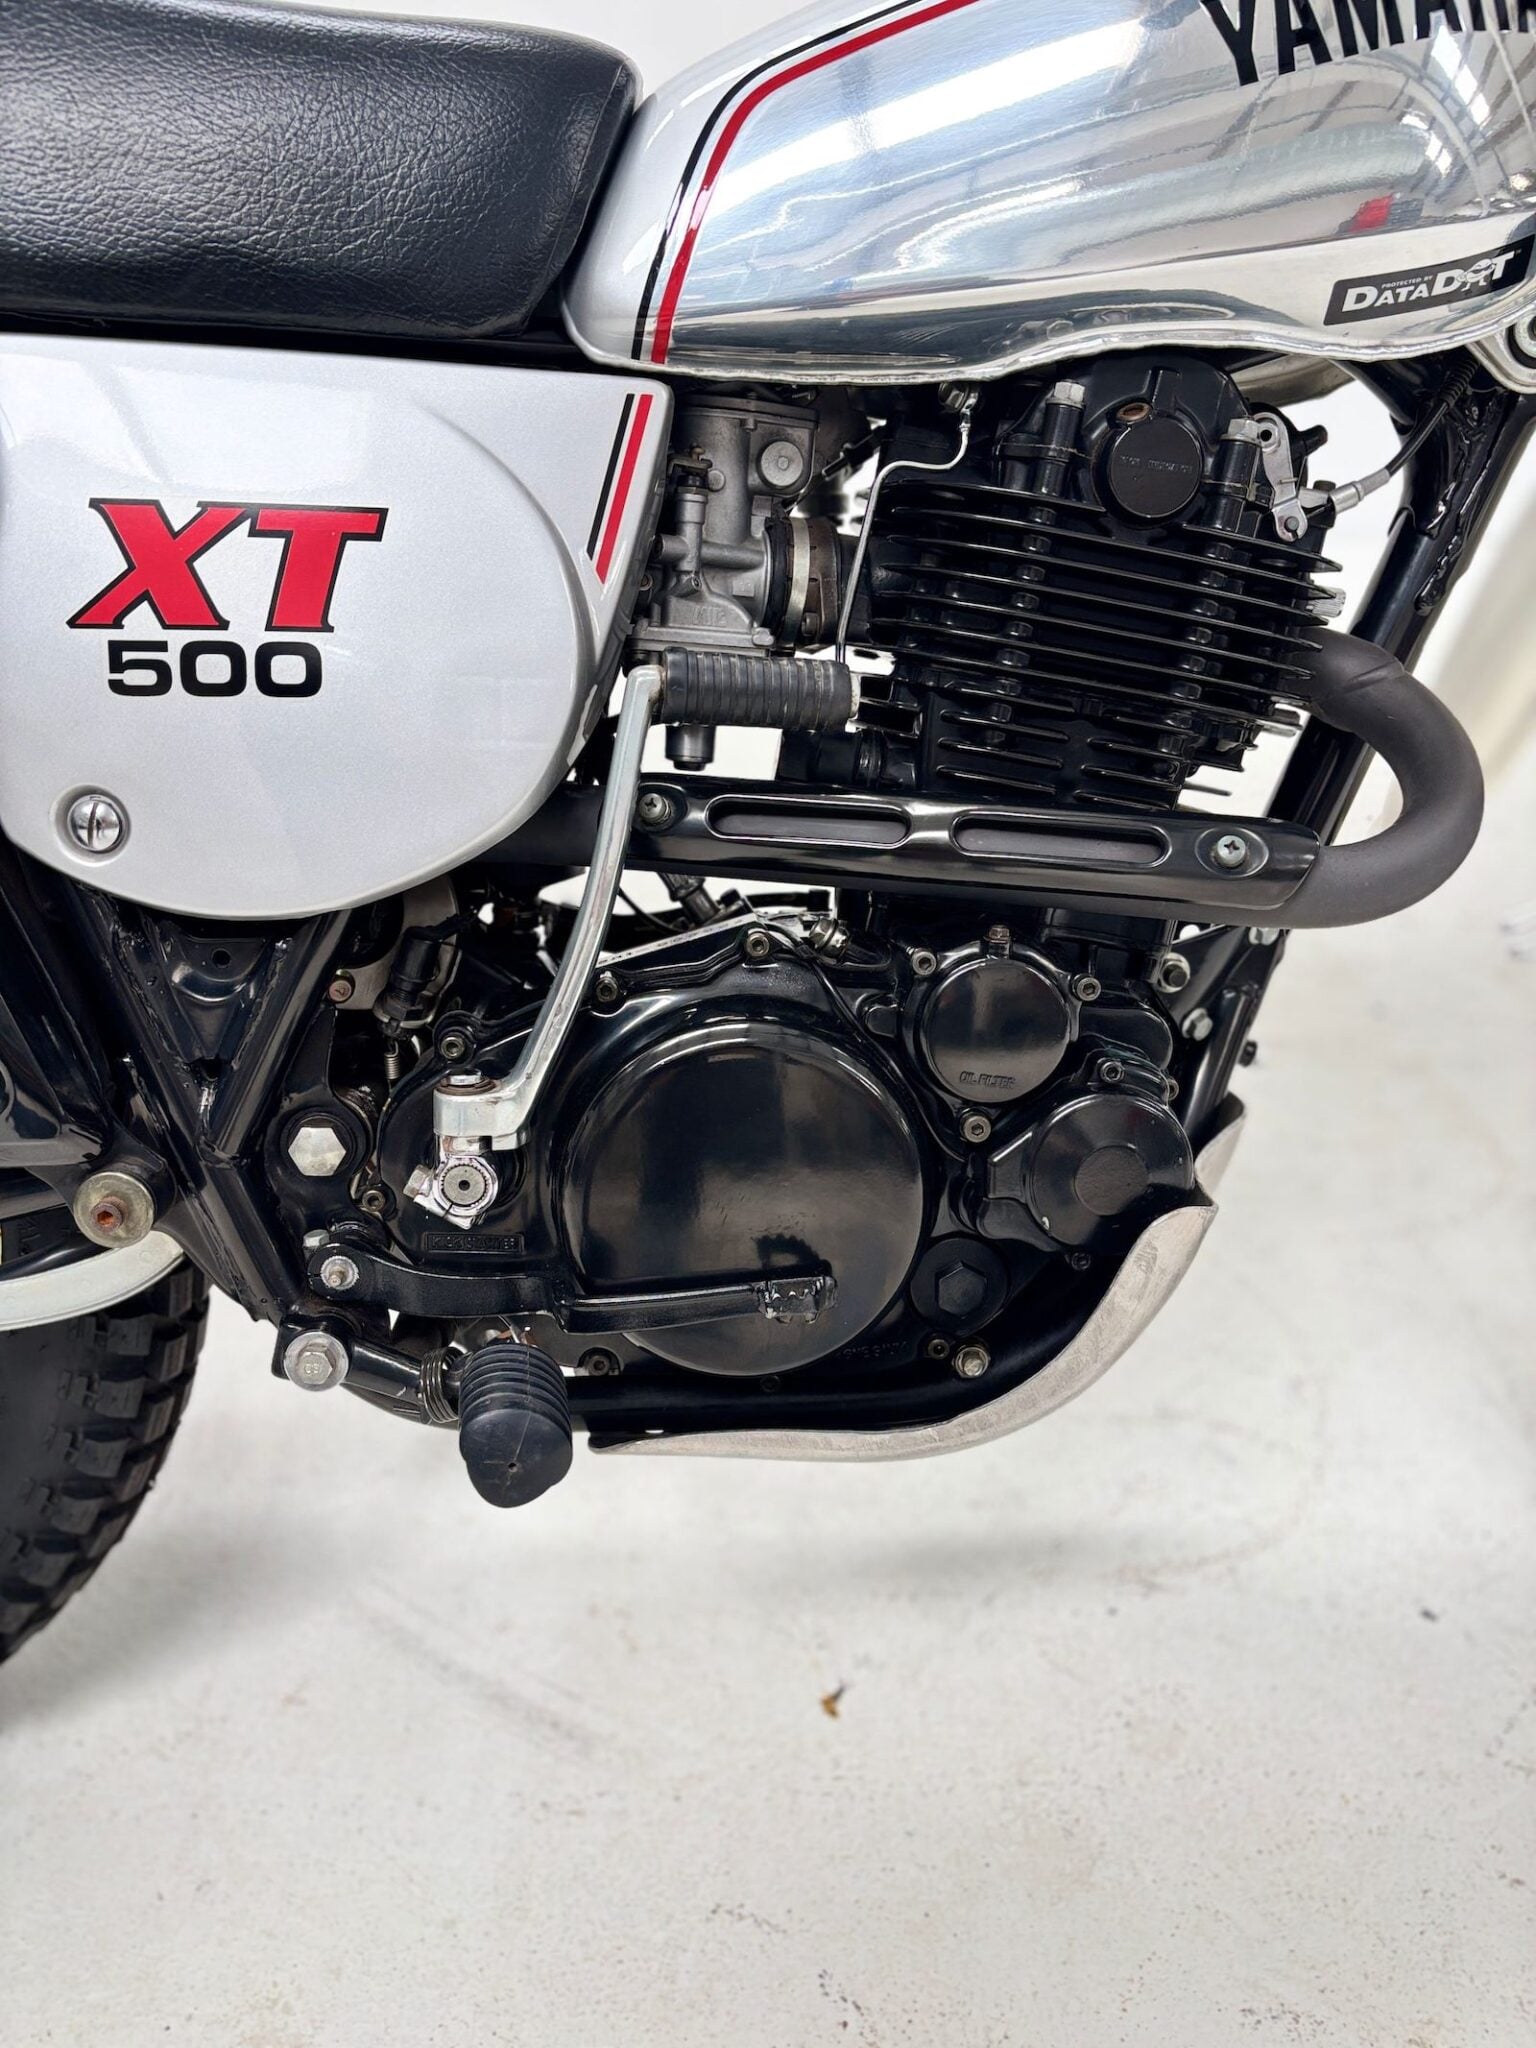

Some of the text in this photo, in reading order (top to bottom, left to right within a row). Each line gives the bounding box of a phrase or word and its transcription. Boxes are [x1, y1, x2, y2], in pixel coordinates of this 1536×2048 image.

[1381, 277, 1422, 289] PROTECTED
[66, 497, 389, 633] XT
[107, 640, 322, 698] 500
